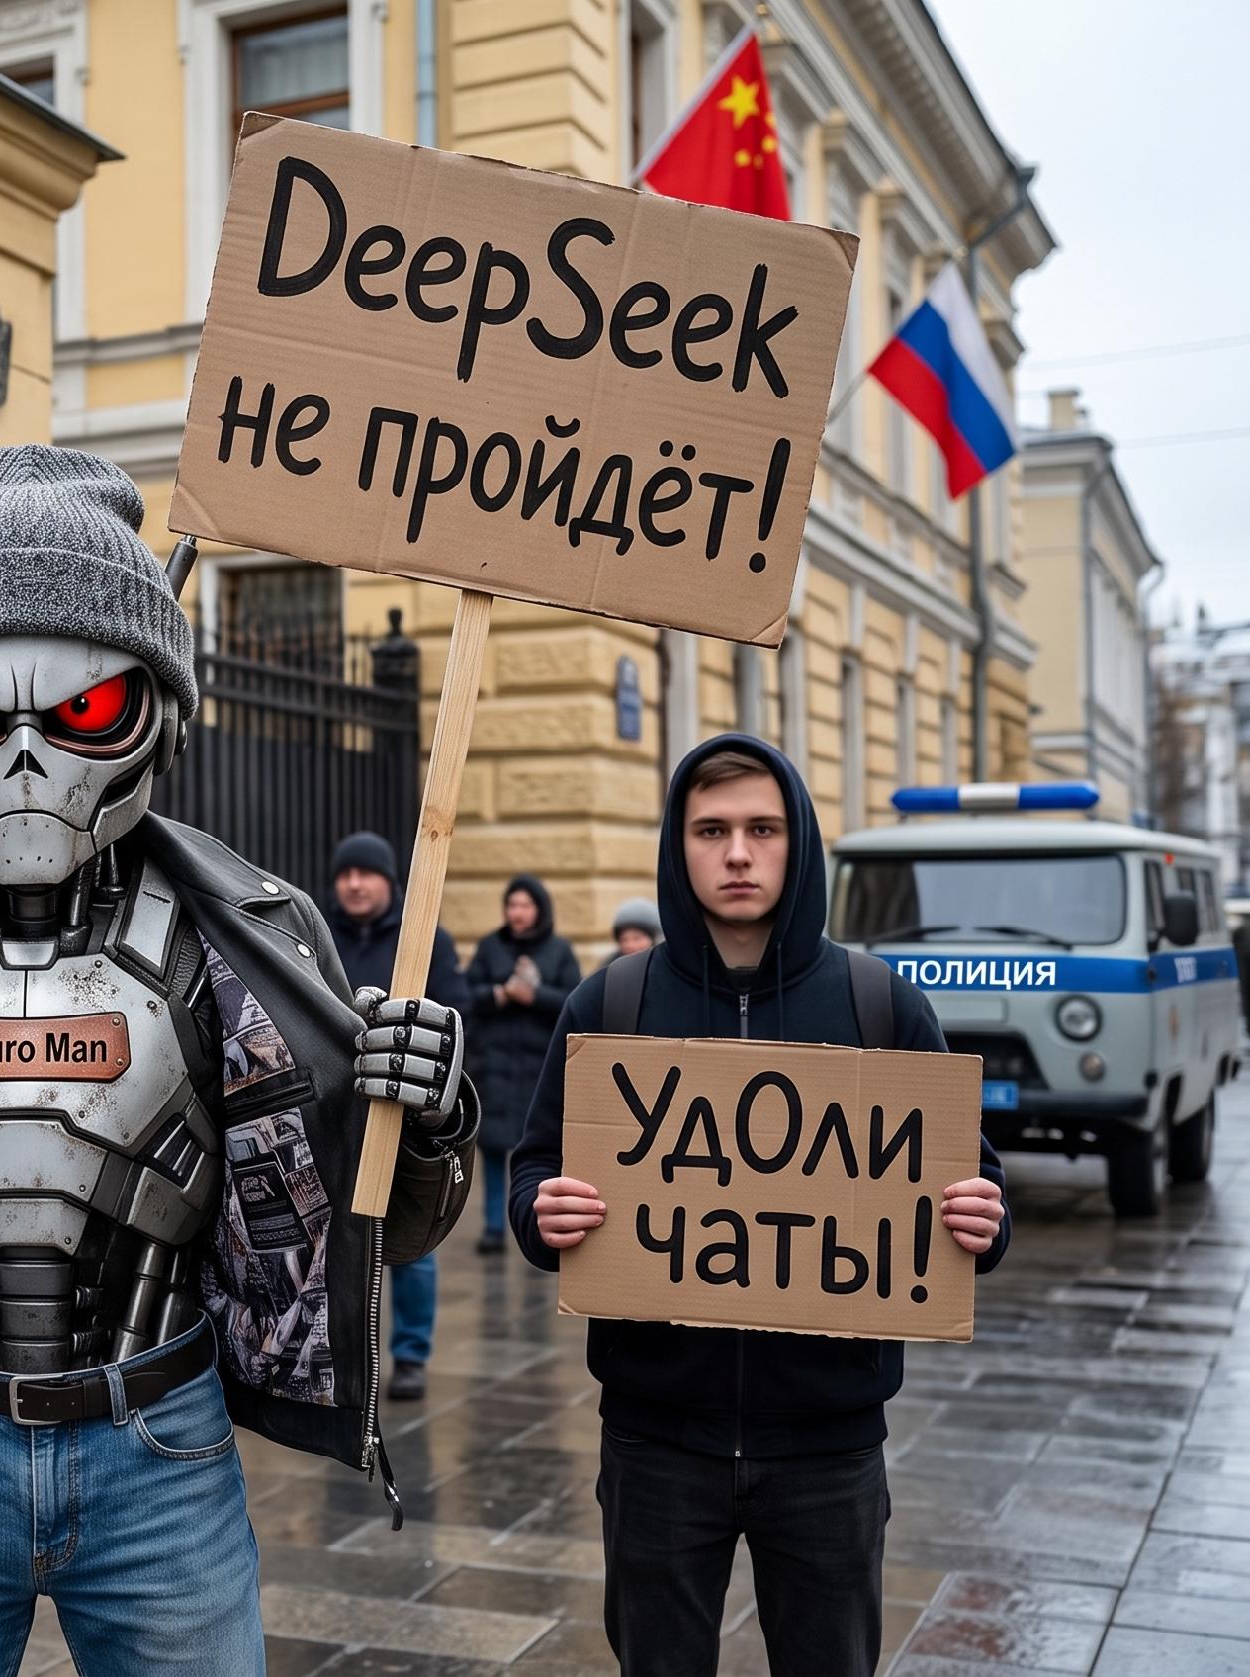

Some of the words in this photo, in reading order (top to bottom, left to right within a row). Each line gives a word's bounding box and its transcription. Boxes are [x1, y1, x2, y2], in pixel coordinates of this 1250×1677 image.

[258, 156, 799, 398] DeepSeek
[218, 376, 330, 476] не
[358, 407, 791, 573] пройдёт!
[897, 960, 1057, 990] ПОЛИЦИЯ
[45, 1032, 107, 1063] Man
[636, 1195, 933, 1304] чаты!
